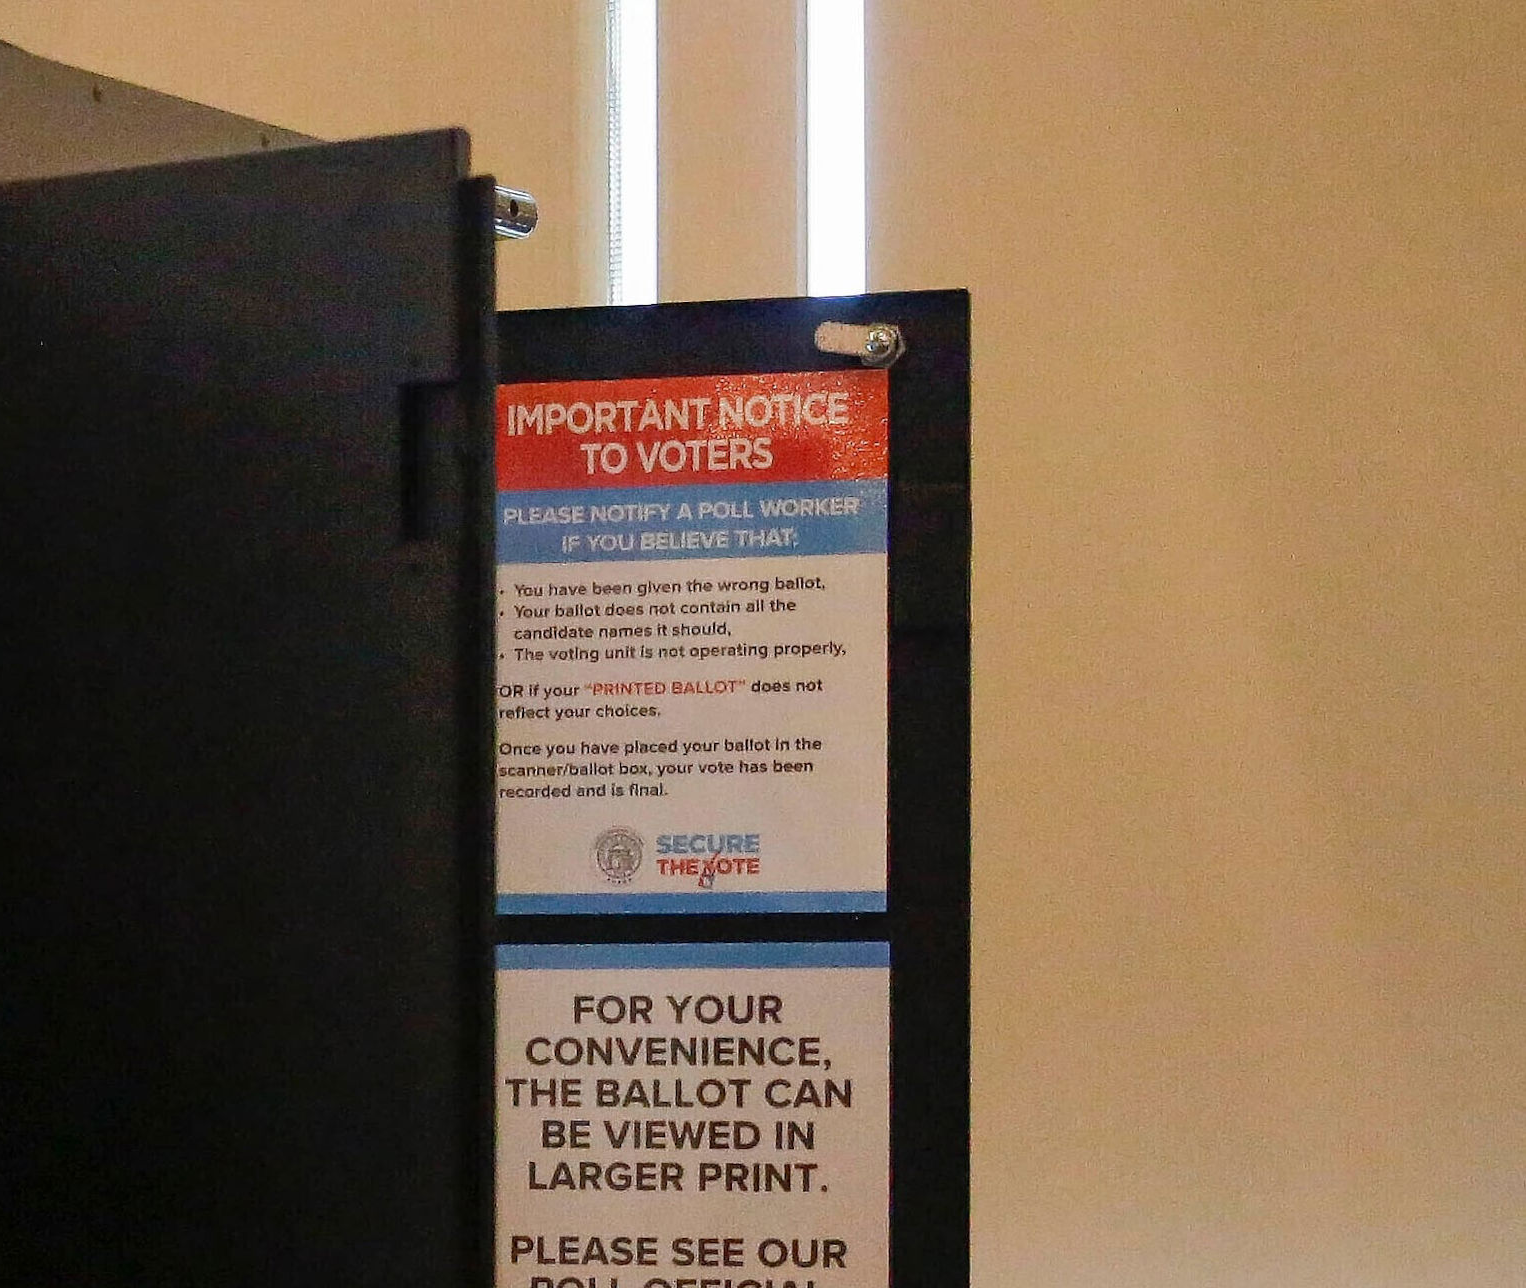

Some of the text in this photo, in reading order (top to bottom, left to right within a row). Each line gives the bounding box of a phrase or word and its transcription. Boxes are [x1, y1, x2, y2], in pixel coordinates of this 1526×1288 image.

[507, 393, 849, 436] IMPORTANT NOTICE
[580, 438, 773, 475] TO VOTERS
[503, 498, 860, 525] PLEASE NOTIFY A POLL WORKER
[561, 535, 580, 552] IF
[585, 534, 634, 551] YOU
[640, 531, 730, 550] BELIEVE
[515, 584, 543, 597] You
[548, 583, 587, 596] have
[592, 581, 632, 595] been
[637, 580, 681, 598] given
[685, 579, 713, 593] the
[717, 579, 769, 594] wrong
[514, 600, 796, 618] Your ballot does not contain all the
[513, 626, 593, 640] candidate
[599, 627, 652, 638] names
[656, 624, 668, 637] it
[515, 641, 846, 662] The voting unit is not operating properly,
[498, 684, 523, 698] OR
[528, 684, 540, 696] if
[544, 685, 579, 700] your
[751, 680, 791, 692] does
[795, 680, 823, 692] not
[498, 704, 661, 722] reflect your choices.
[498, 737, 822, 759] Once you have placed your ballot in the
[498, 760, 814, 778] scanner/ballot box, your vote has been
[498, 784, 571, 799] recorded
[576, 784, 606, 797] and
[611, 783, 625, 797] is
[656, 834, 761, 854] SECURE
[657, 859, 699, 876] THE
[573, 994, 783, 1024] FOR YOUR
[525, 1037, 832, 1070] CONVENIENCE,
[505, 1077, 852, 1108] THE BALLOT CAN
[542, 1120, 814, 1149] BE VIEWED IN
[528, 1161, 828, 1192] LARGER PRINT.
[511, 1236, 847, 1268] PLEASE SEE OUR
